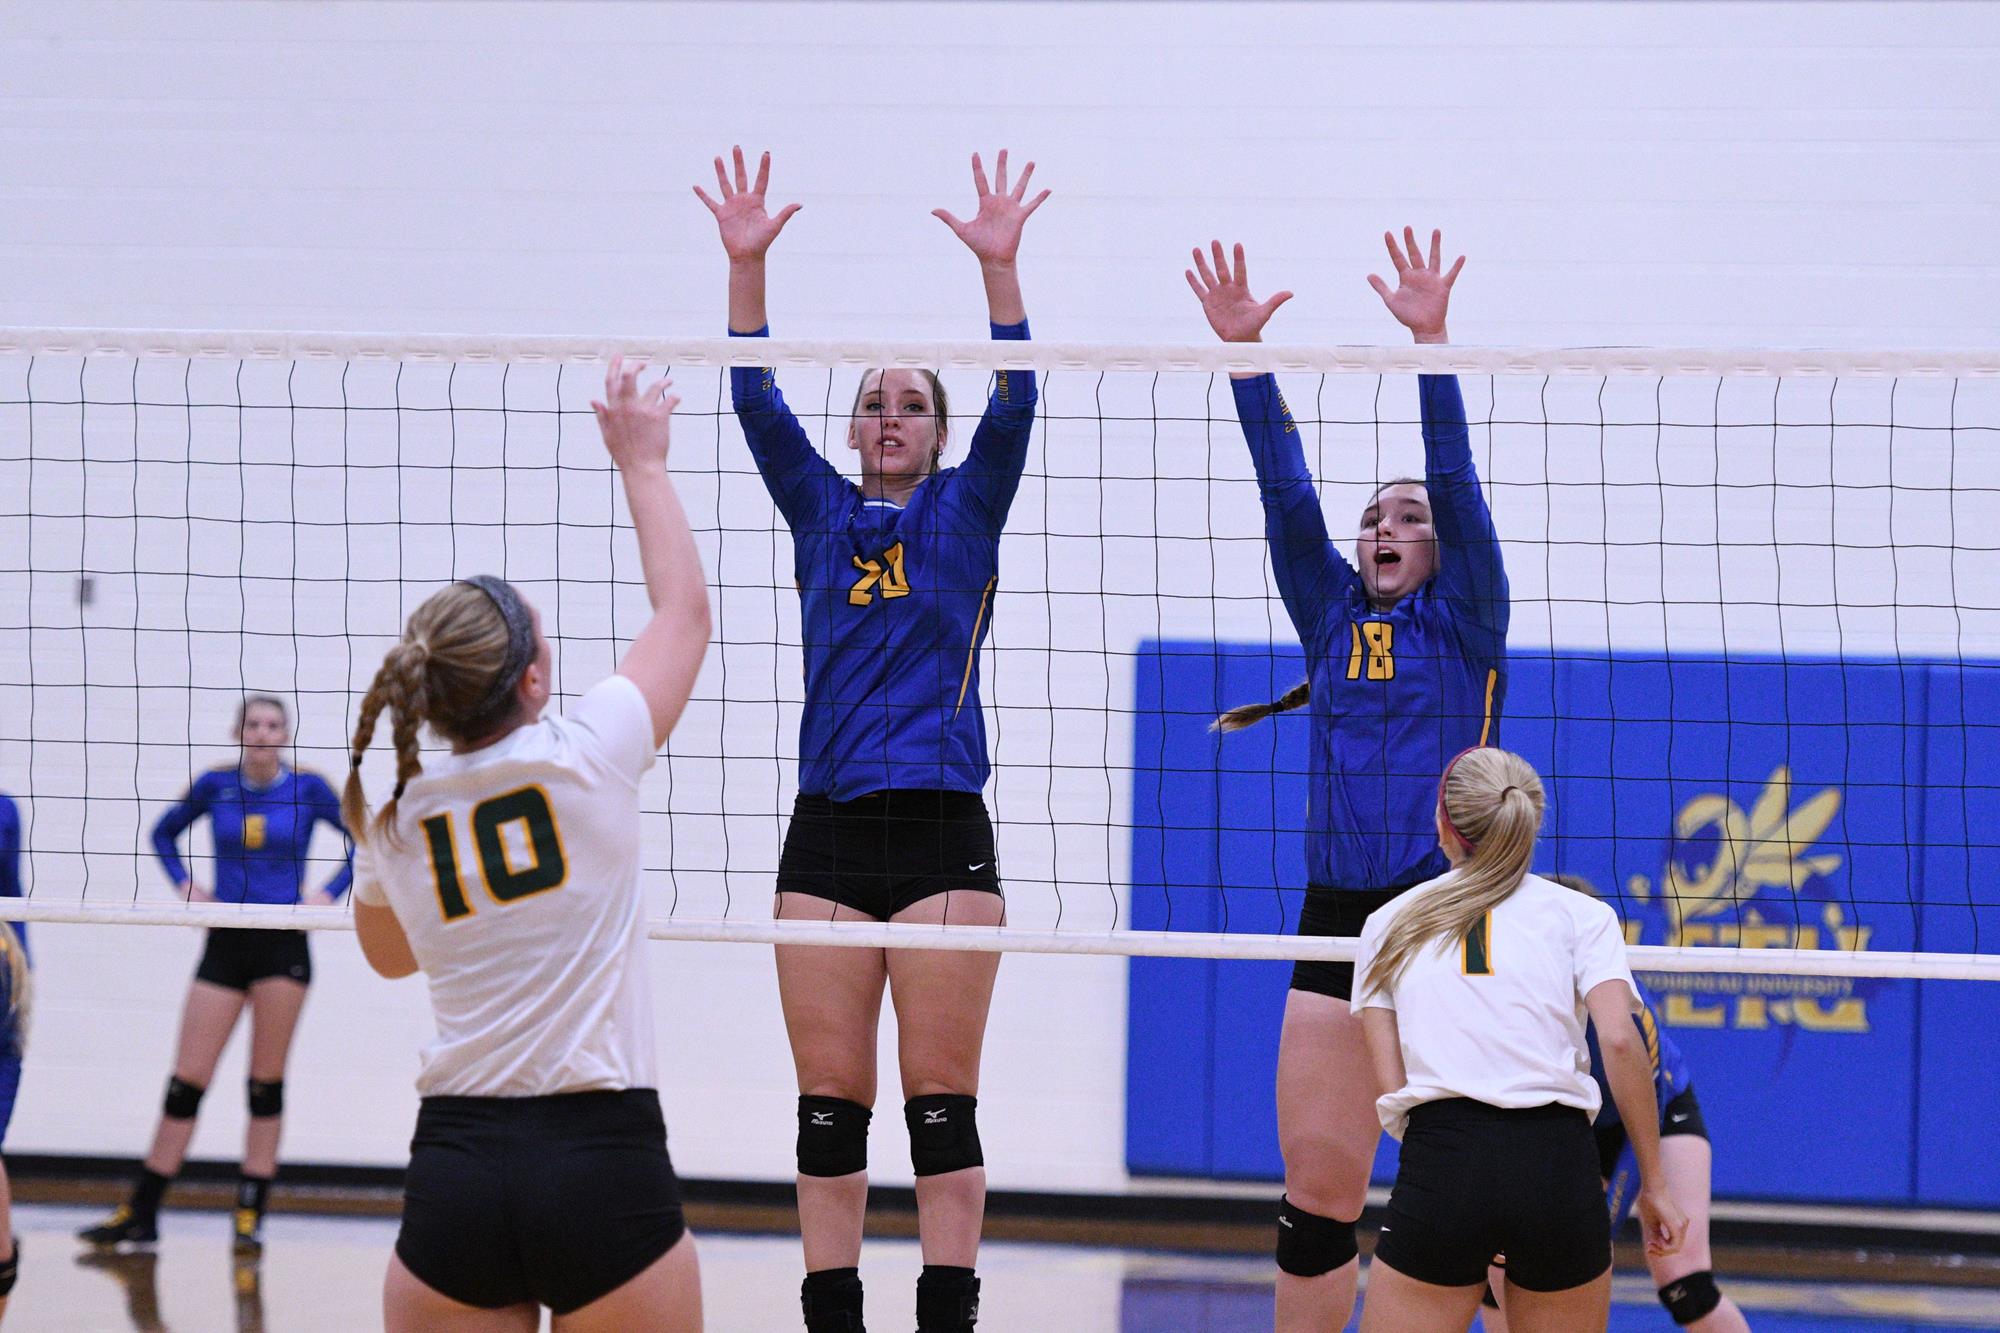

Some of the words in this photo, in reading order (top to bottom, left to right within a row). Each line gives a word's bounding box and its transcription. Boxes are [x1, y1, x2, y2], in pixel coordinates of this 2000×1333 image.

[848, 540, 912, 607] 20
[1345, 621, 1396, 680] 18
[418, 783, 571, 925] 10
[1461, 906, 1495, 977] 1
[1618, 919, 1873, 1034] ETU
